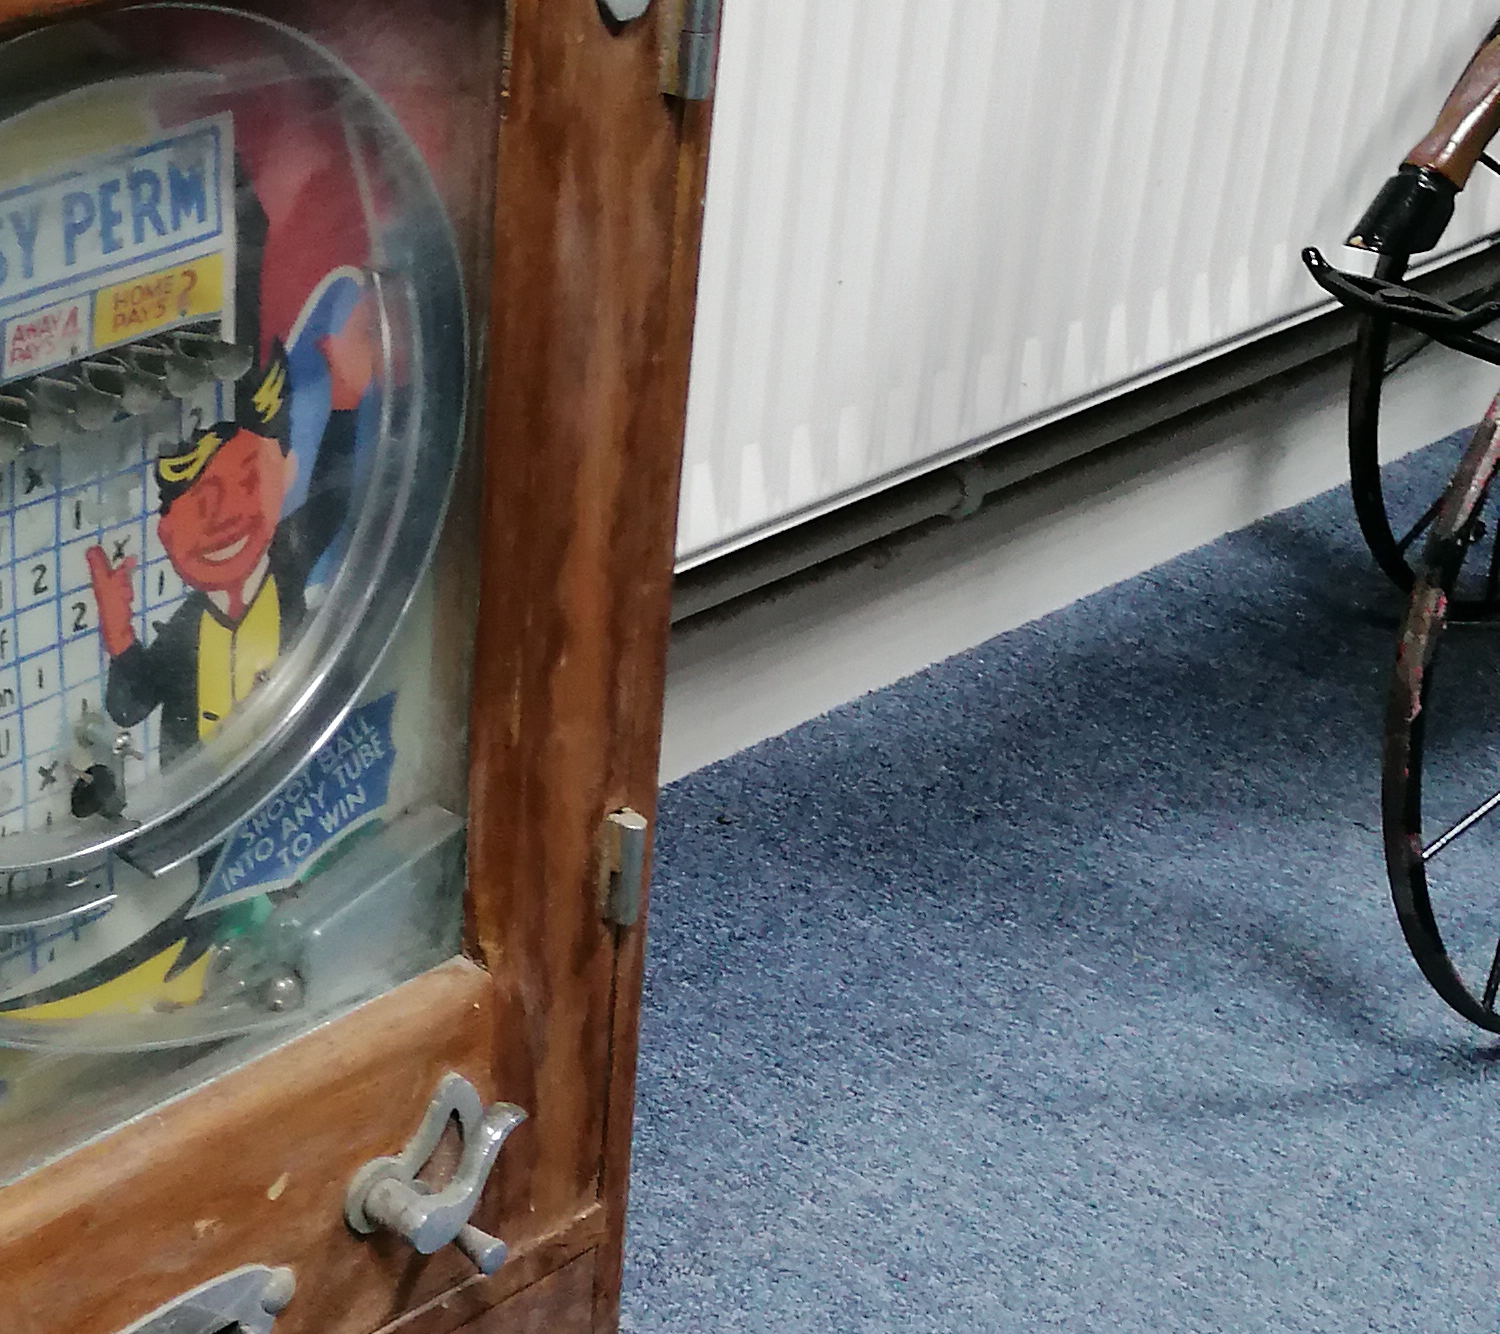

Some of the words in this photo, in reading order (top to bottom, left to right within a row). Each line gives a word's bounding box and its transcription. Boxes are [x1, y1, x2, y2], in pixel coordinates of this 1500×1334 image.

[61, 161, 208, 267] PERM
[12, 311, 60, 345] AWAY
[112, 296, 167, 332] PAYS
[113, 274, 174, 311] HOME
[220, 837, 275, 891] INTO
[281, 781, 325, 841] ANY
[332, 731, 386, 789] TUBE
[241, 766, 314, 847] SHOOT
[316, 716, 377, 774] BALL
[277, 832, 312, 867] TO
[319, 784, 367, 834] WIN
